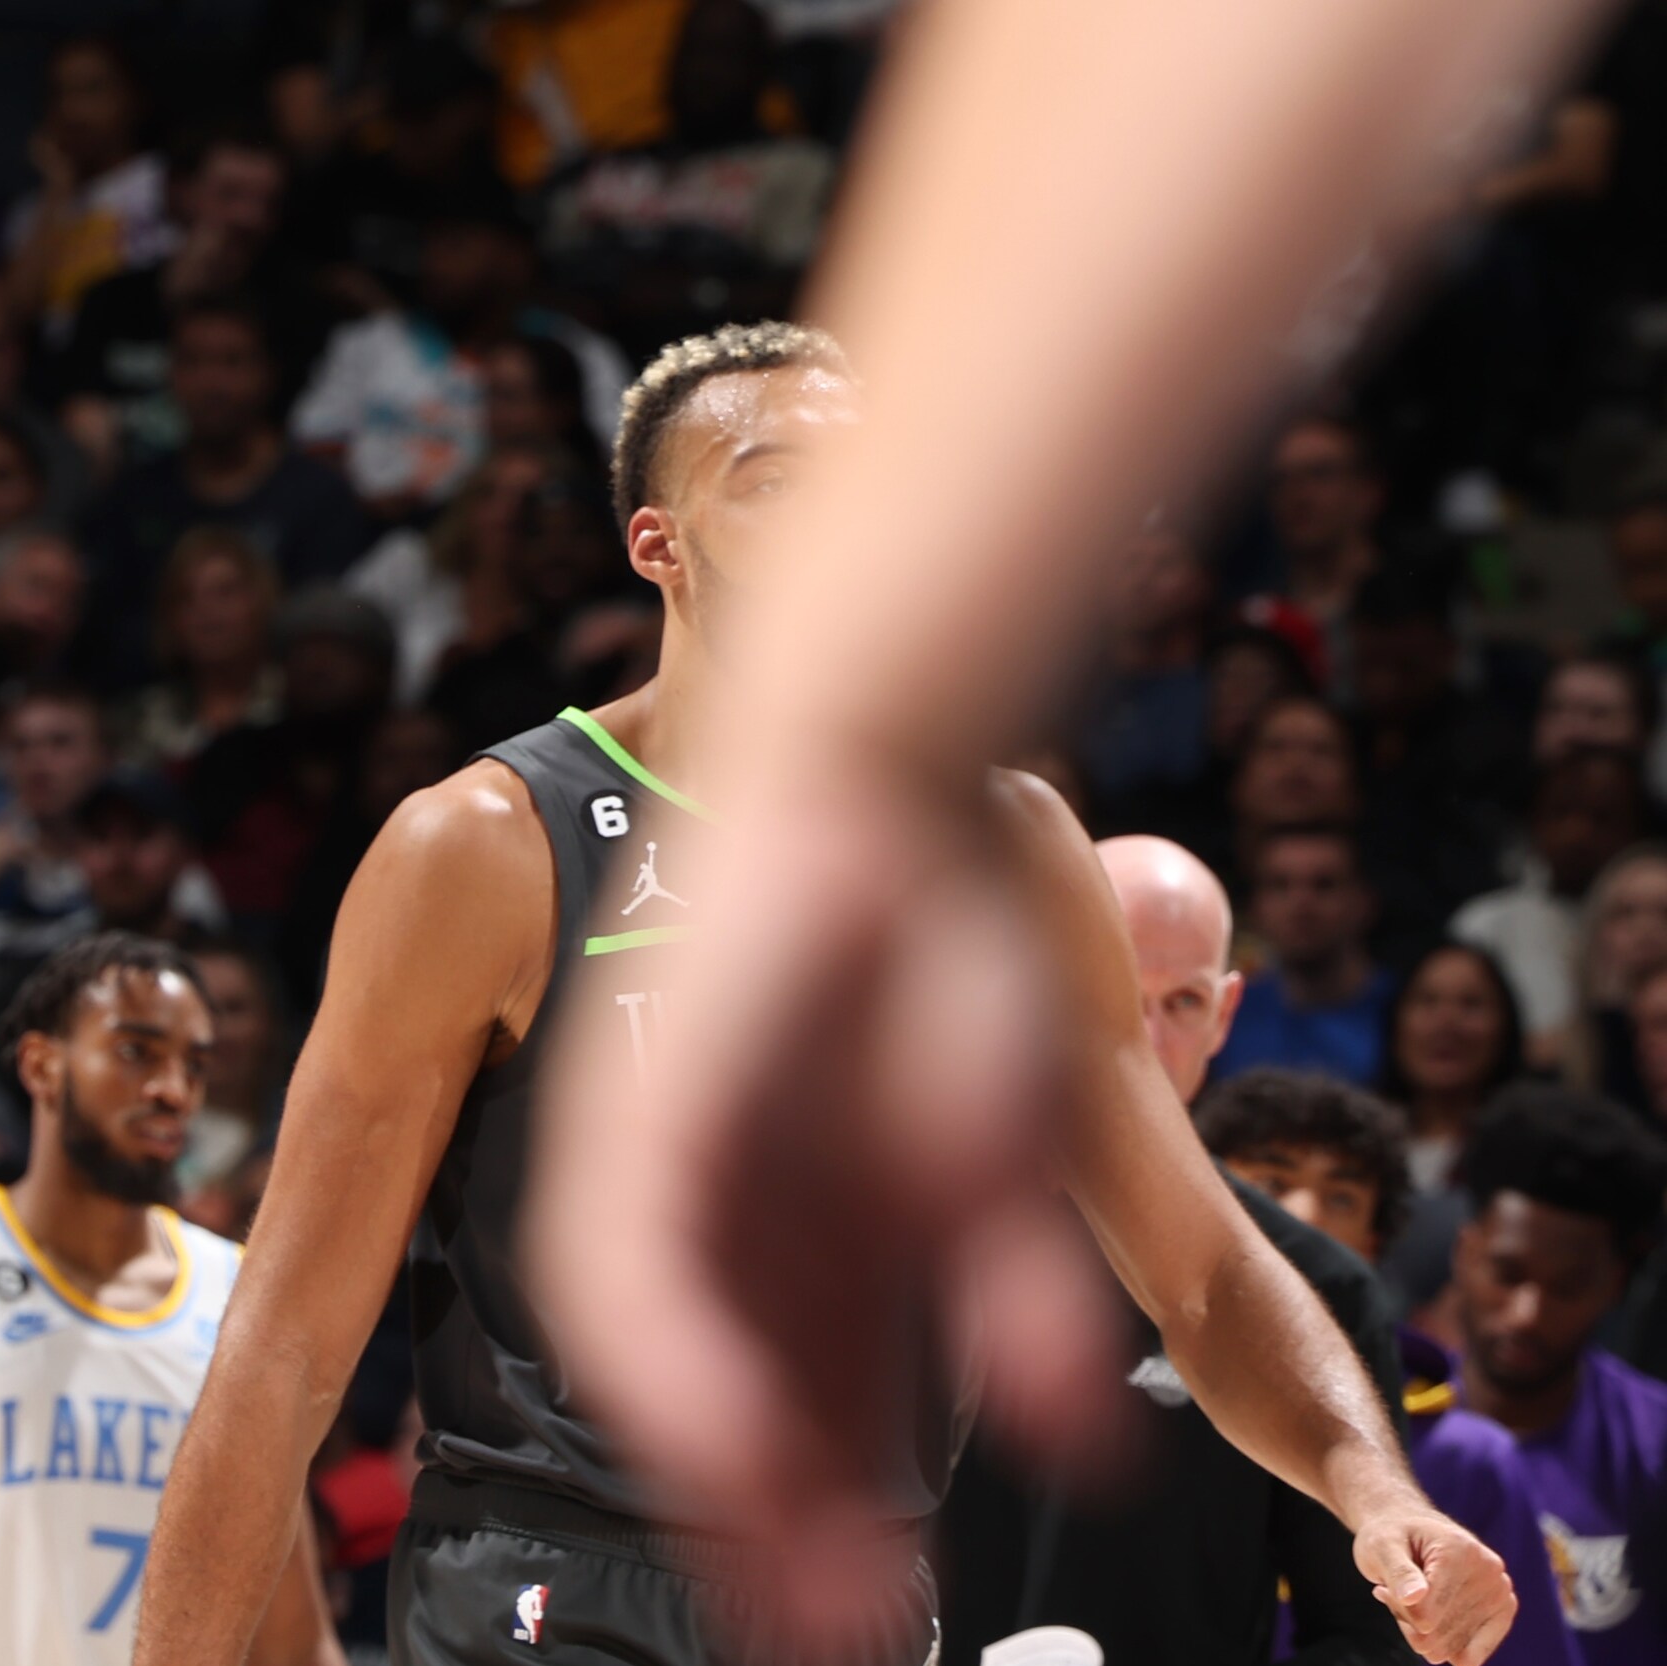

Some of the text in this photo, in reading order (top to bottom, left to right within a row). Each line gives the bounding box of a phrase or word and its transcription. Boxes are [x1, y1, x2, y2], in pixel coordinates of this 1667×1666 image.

[590, 795, 630, 838] 6
[0, 1395, 189, 1491] LAKE
[85, 1526, 153, 1633] 7
